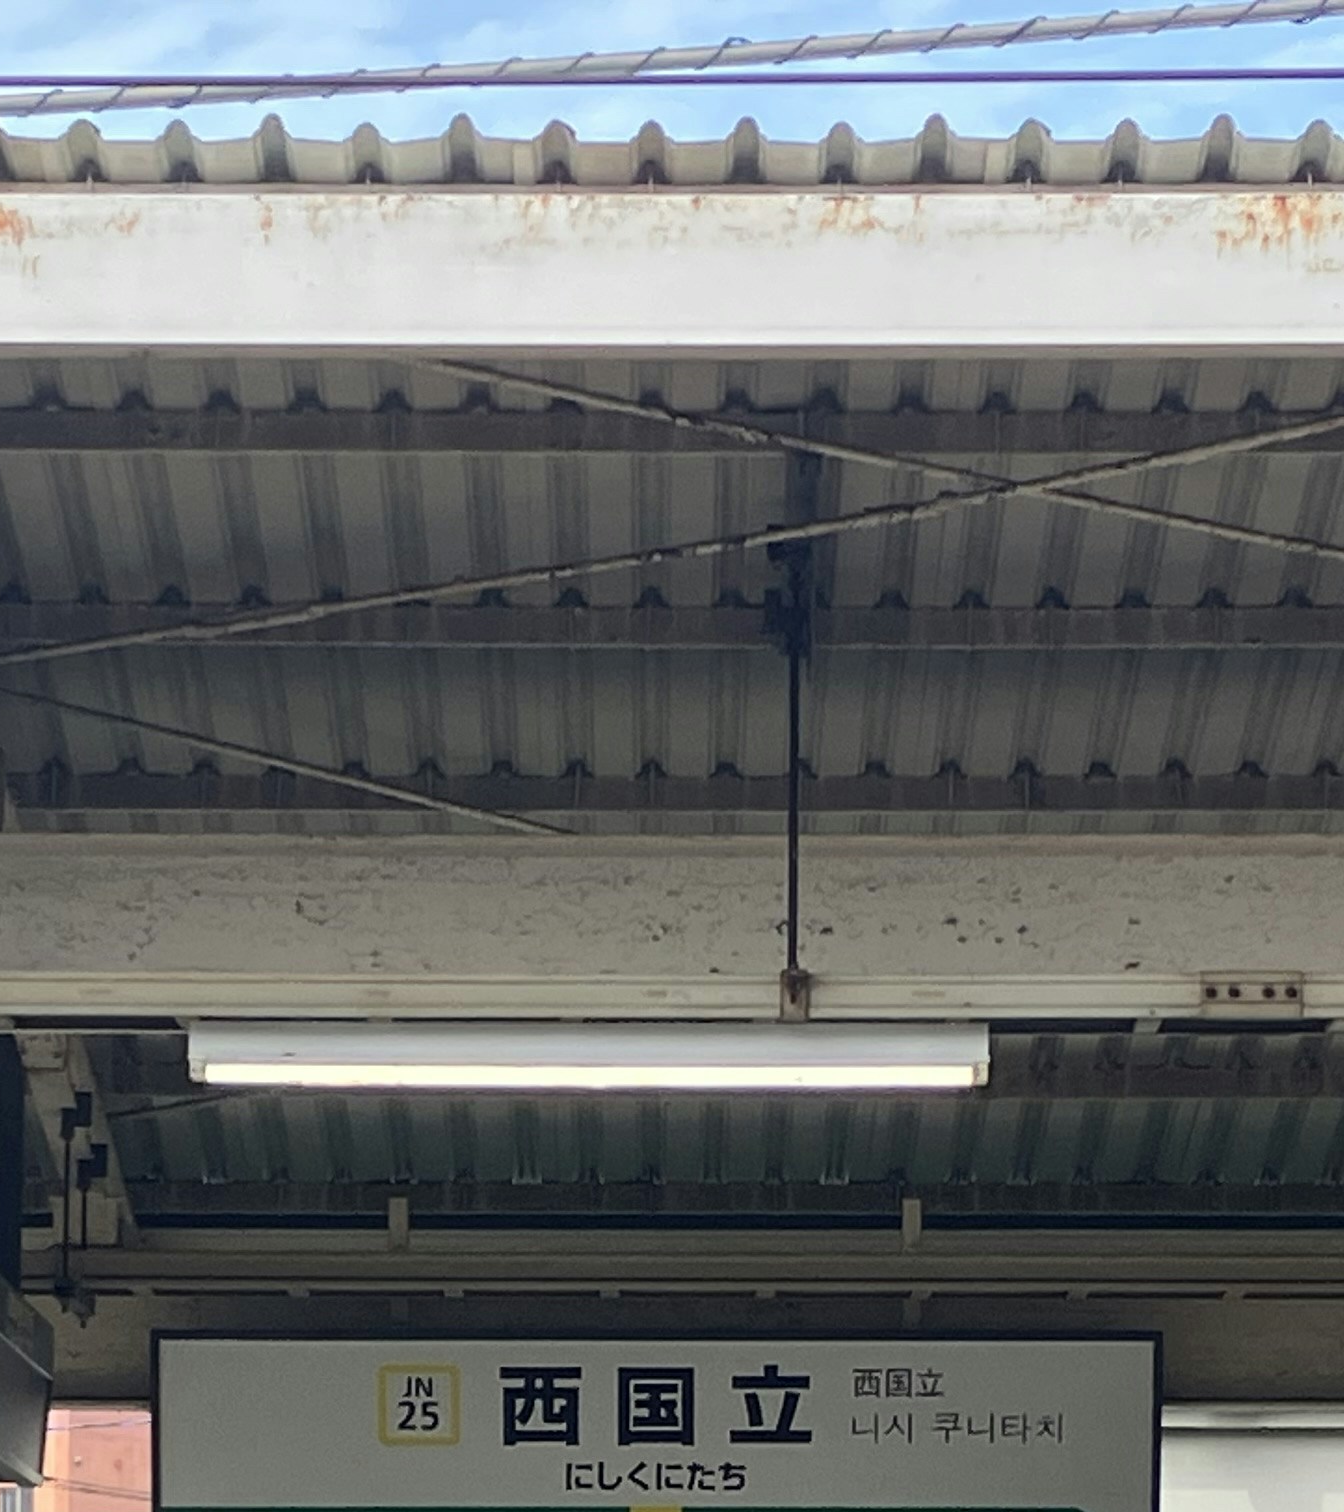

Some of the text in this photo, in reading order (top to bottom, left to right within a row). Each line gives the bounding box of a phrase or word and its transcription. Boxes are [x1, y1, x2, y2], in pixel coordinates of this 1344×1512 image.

[402, 1375, 434, 1398] JN
[851, 1367, 946, 1399] 西国立
[396, 1401, 441, 1432] 25
[498, 1365, 813, 1447] 西国立
[851, 1412, 1066, 1445] 니시 쿠니타치
[564, 1461, 749, 1492] にしくにたち
